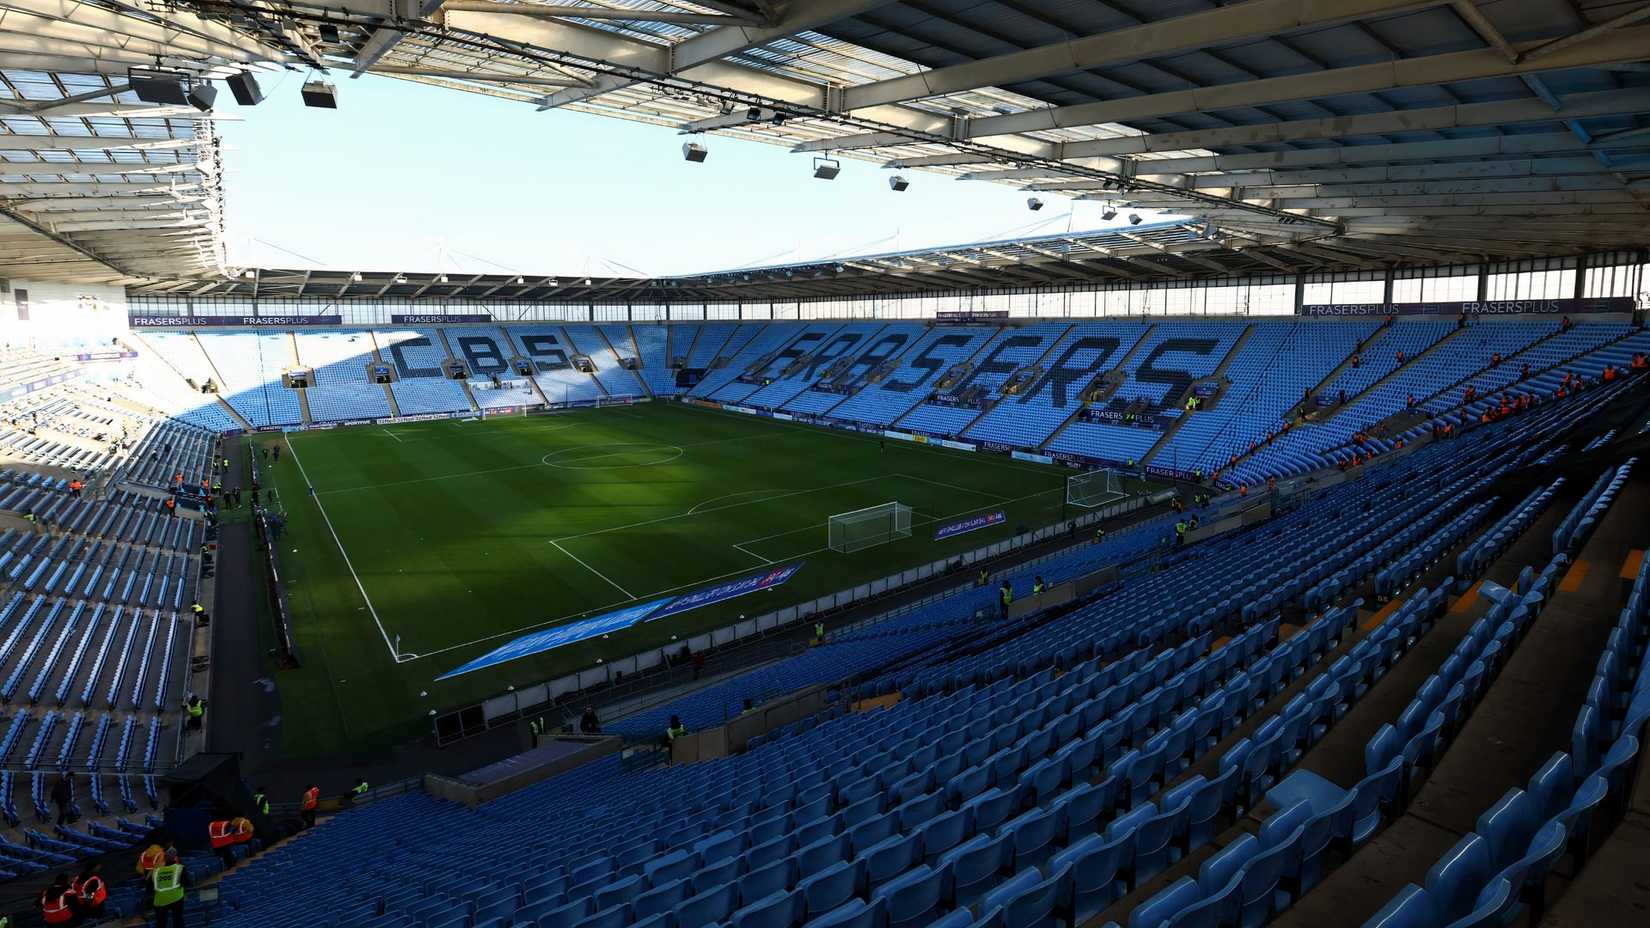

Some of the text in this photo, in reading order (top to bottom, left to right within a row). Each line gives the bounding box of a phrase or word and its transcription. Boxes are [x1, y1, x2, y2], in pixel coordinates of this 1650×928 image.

[1309, 304, 1400, 315] FRASERSPLUS
[1462, 299, 1560, 314] FRASERSPLUS
[134, 317, 207, 326] FRASERSPLUS
[243, 316, 309, 325] FRASERSPLUS
[388, 335, 574, 379] CBS
[755, 332, 1220, 412] FRASERS
[1090, 410, 1123, 420] FRASERS
